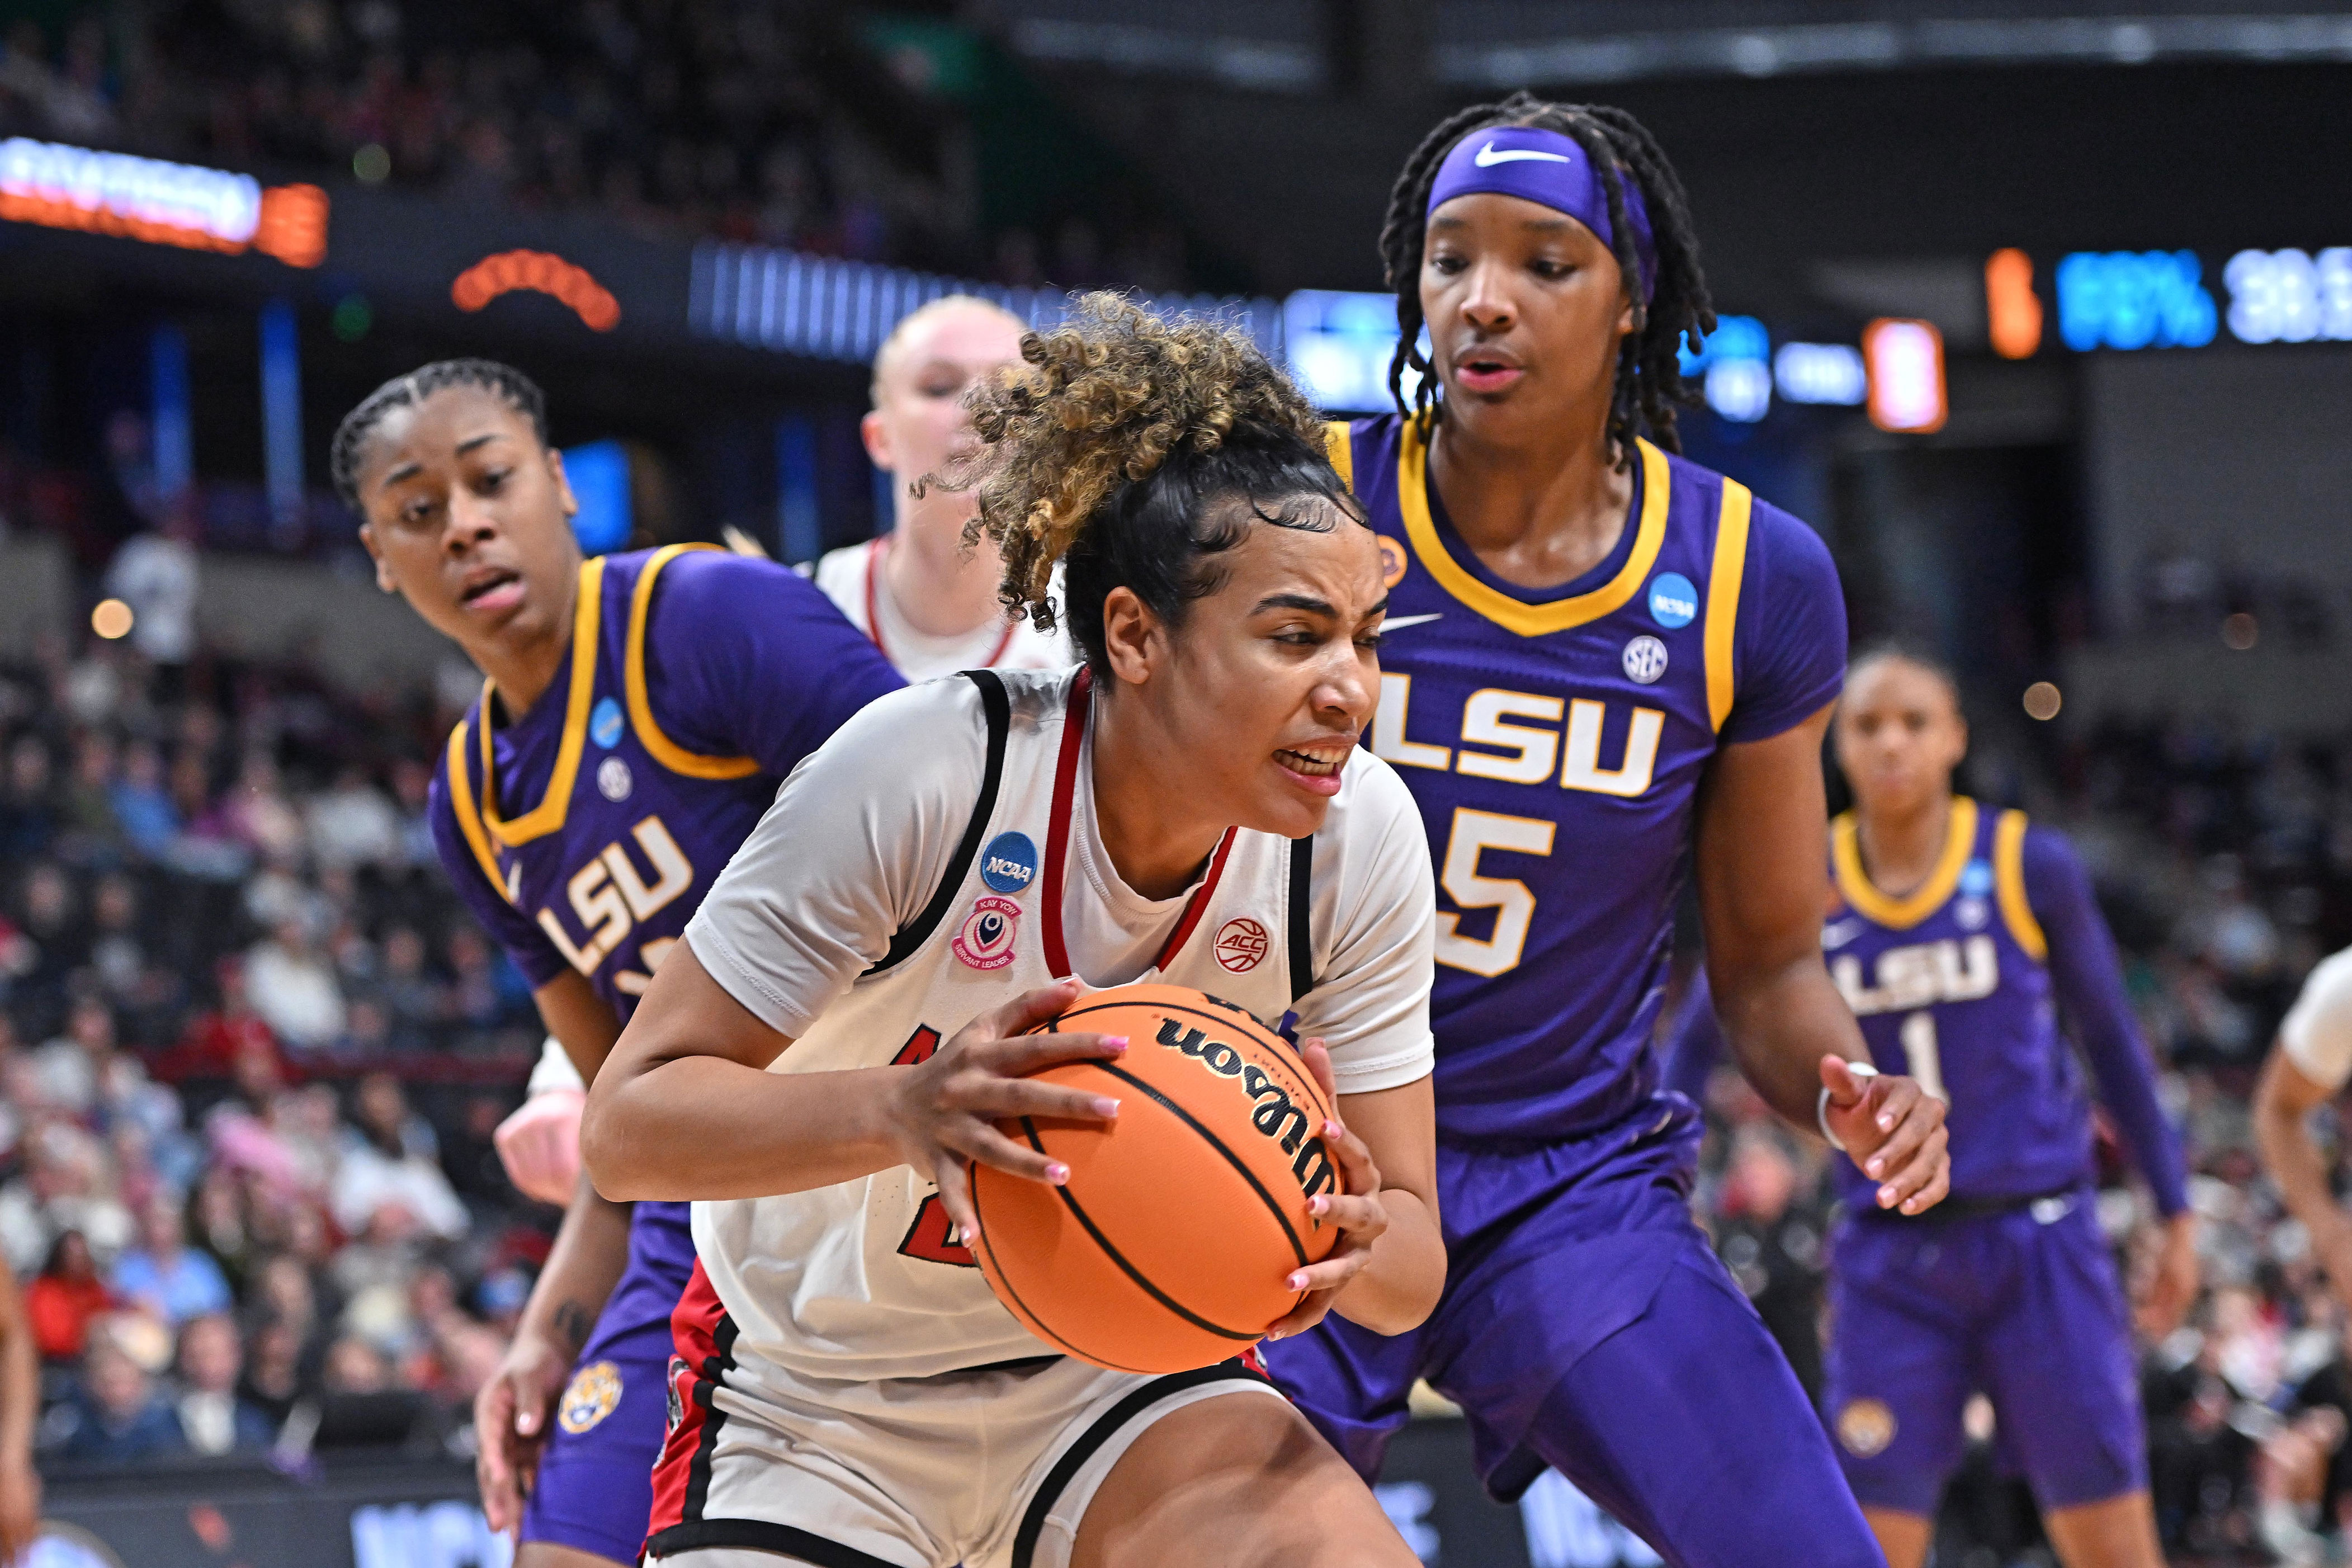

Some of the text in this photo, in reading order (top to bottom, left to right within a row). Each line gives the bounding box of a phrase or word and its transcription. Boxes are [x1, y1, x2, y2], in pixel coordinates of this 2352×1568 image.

[1371, 672, 1666, 797] LSU
[536, 814, 694, 977] LSU
[979, 900, 1018, 916] KAY YOW
[985, 856, 1032, 883] NCAA
[1434, 806, 1557, 978] 5
[954, 943, 1009, 969] SERVANT LEADER
[1220, 934, 1268, 951] ACC
[1829, 933, 1999, 1017] LSU
[1156, 1017, 1336, 1232] Wilson
